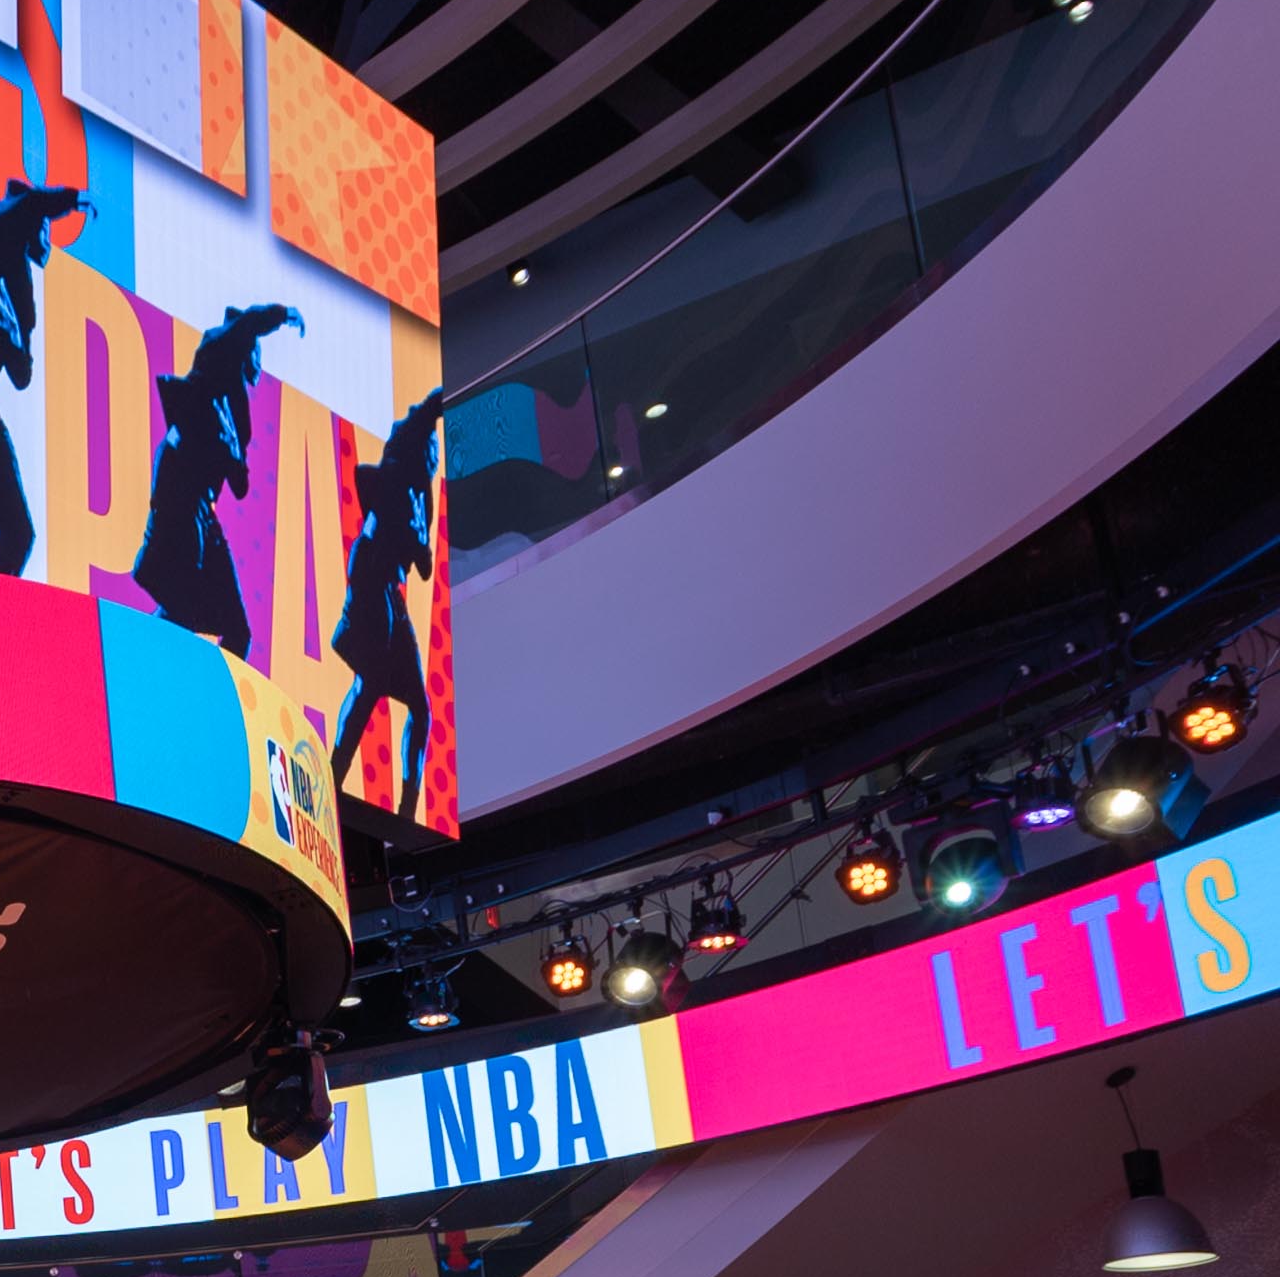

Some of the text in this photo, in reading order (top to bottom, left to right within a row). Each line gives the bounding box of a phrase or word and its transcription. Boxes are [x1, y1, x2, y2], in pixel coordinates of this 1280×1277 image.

[289, 756, 317, 821] NBA
[295, 809, 342, 897] EXPERIENCE
[931, 857, 1252, 1070] LET'S
[422, 1038, 608, 1188] NBA
